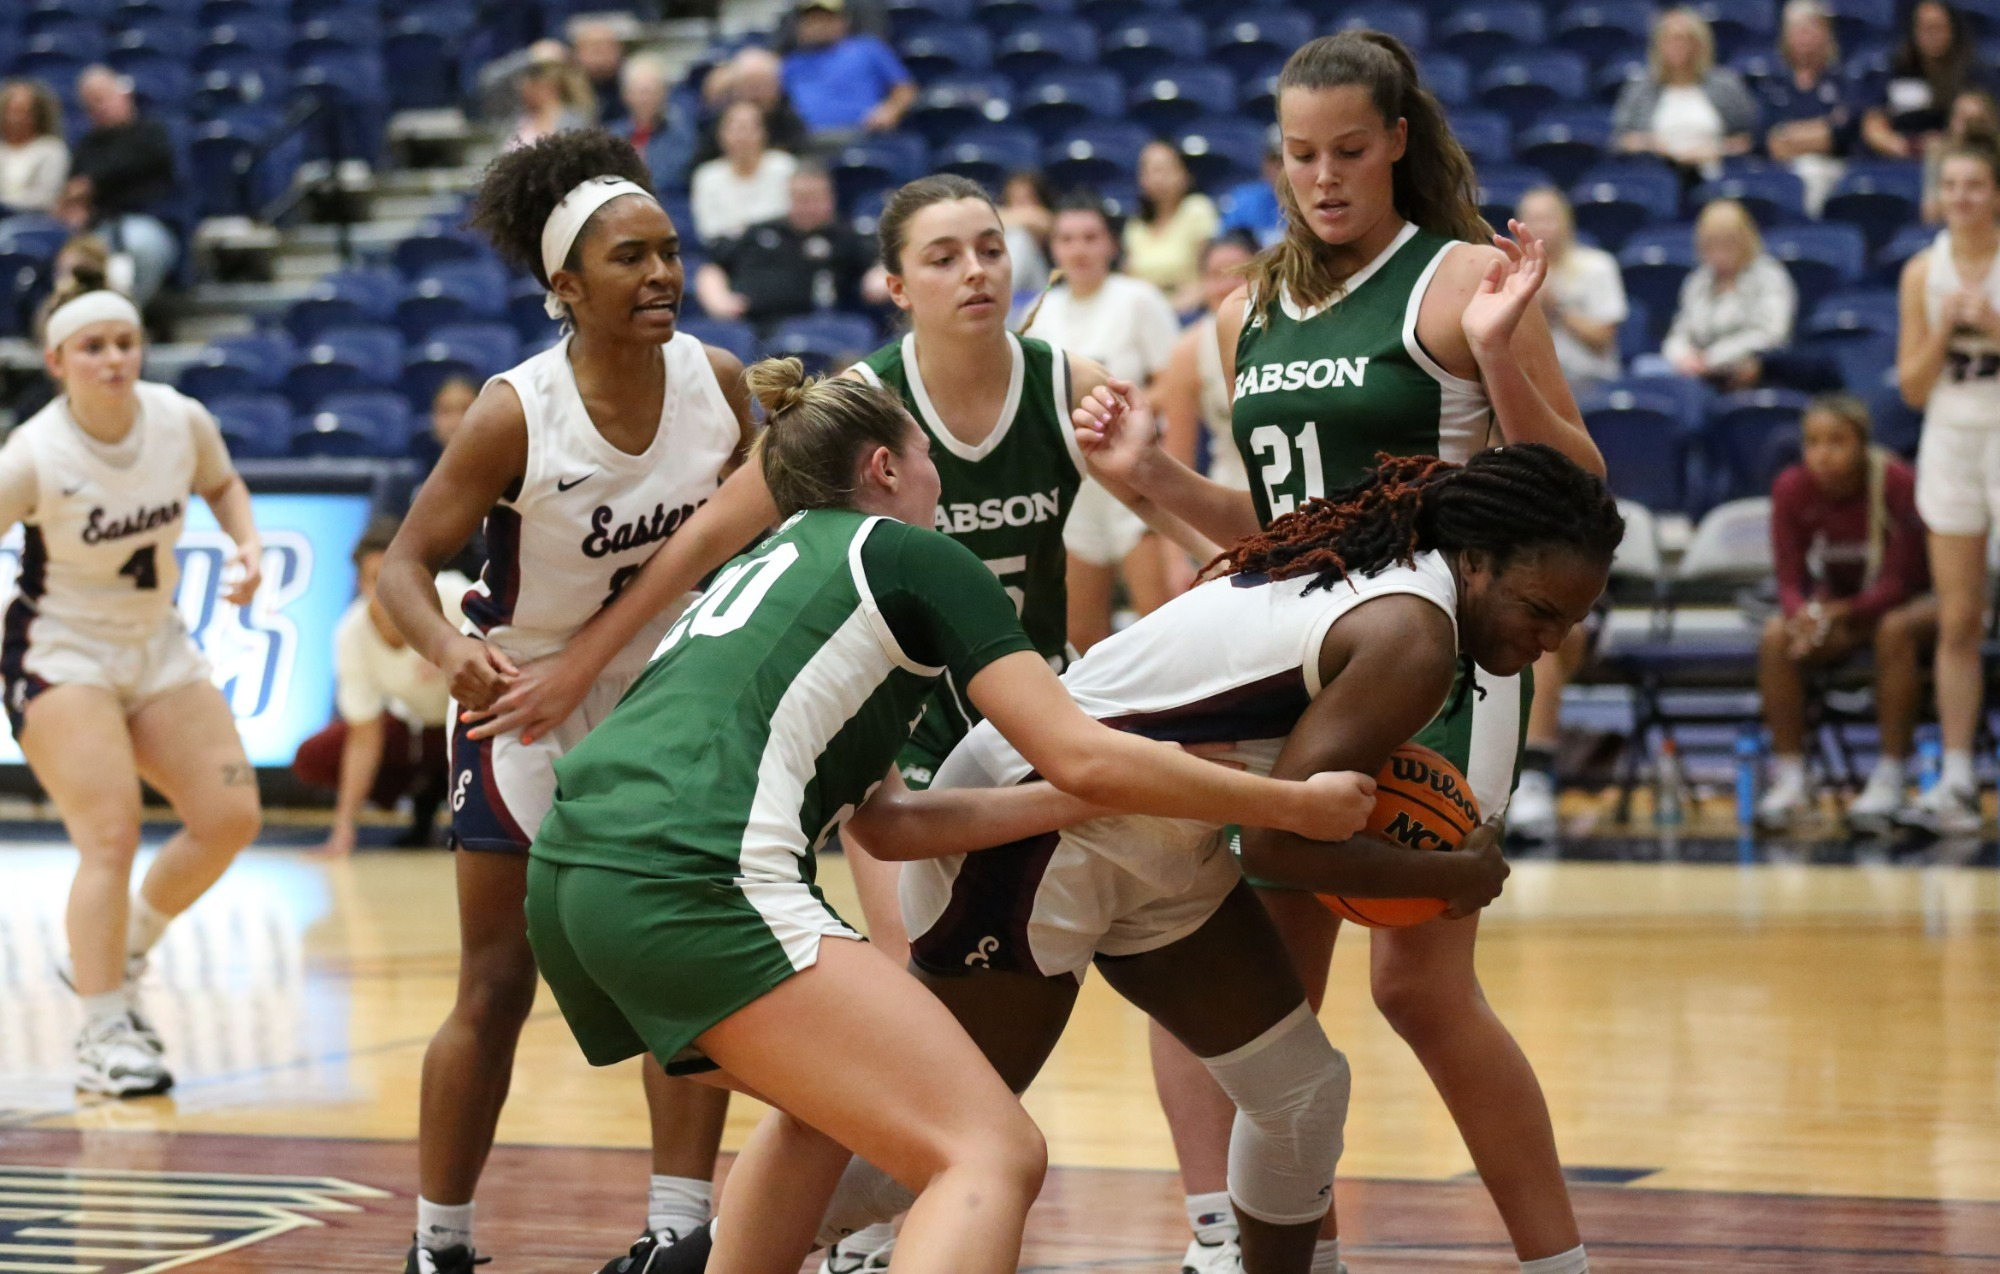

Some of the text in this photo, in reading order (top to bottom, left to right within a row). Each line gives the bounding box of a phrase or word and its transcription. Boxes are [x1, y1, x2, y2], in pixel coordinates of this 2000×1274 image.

[1249, 421, 1325, 522] 21
[581, 498, 709, 558] Easter
[934, 486, 1060, 535] ABSON
[119, 543, 158, 590] 4
